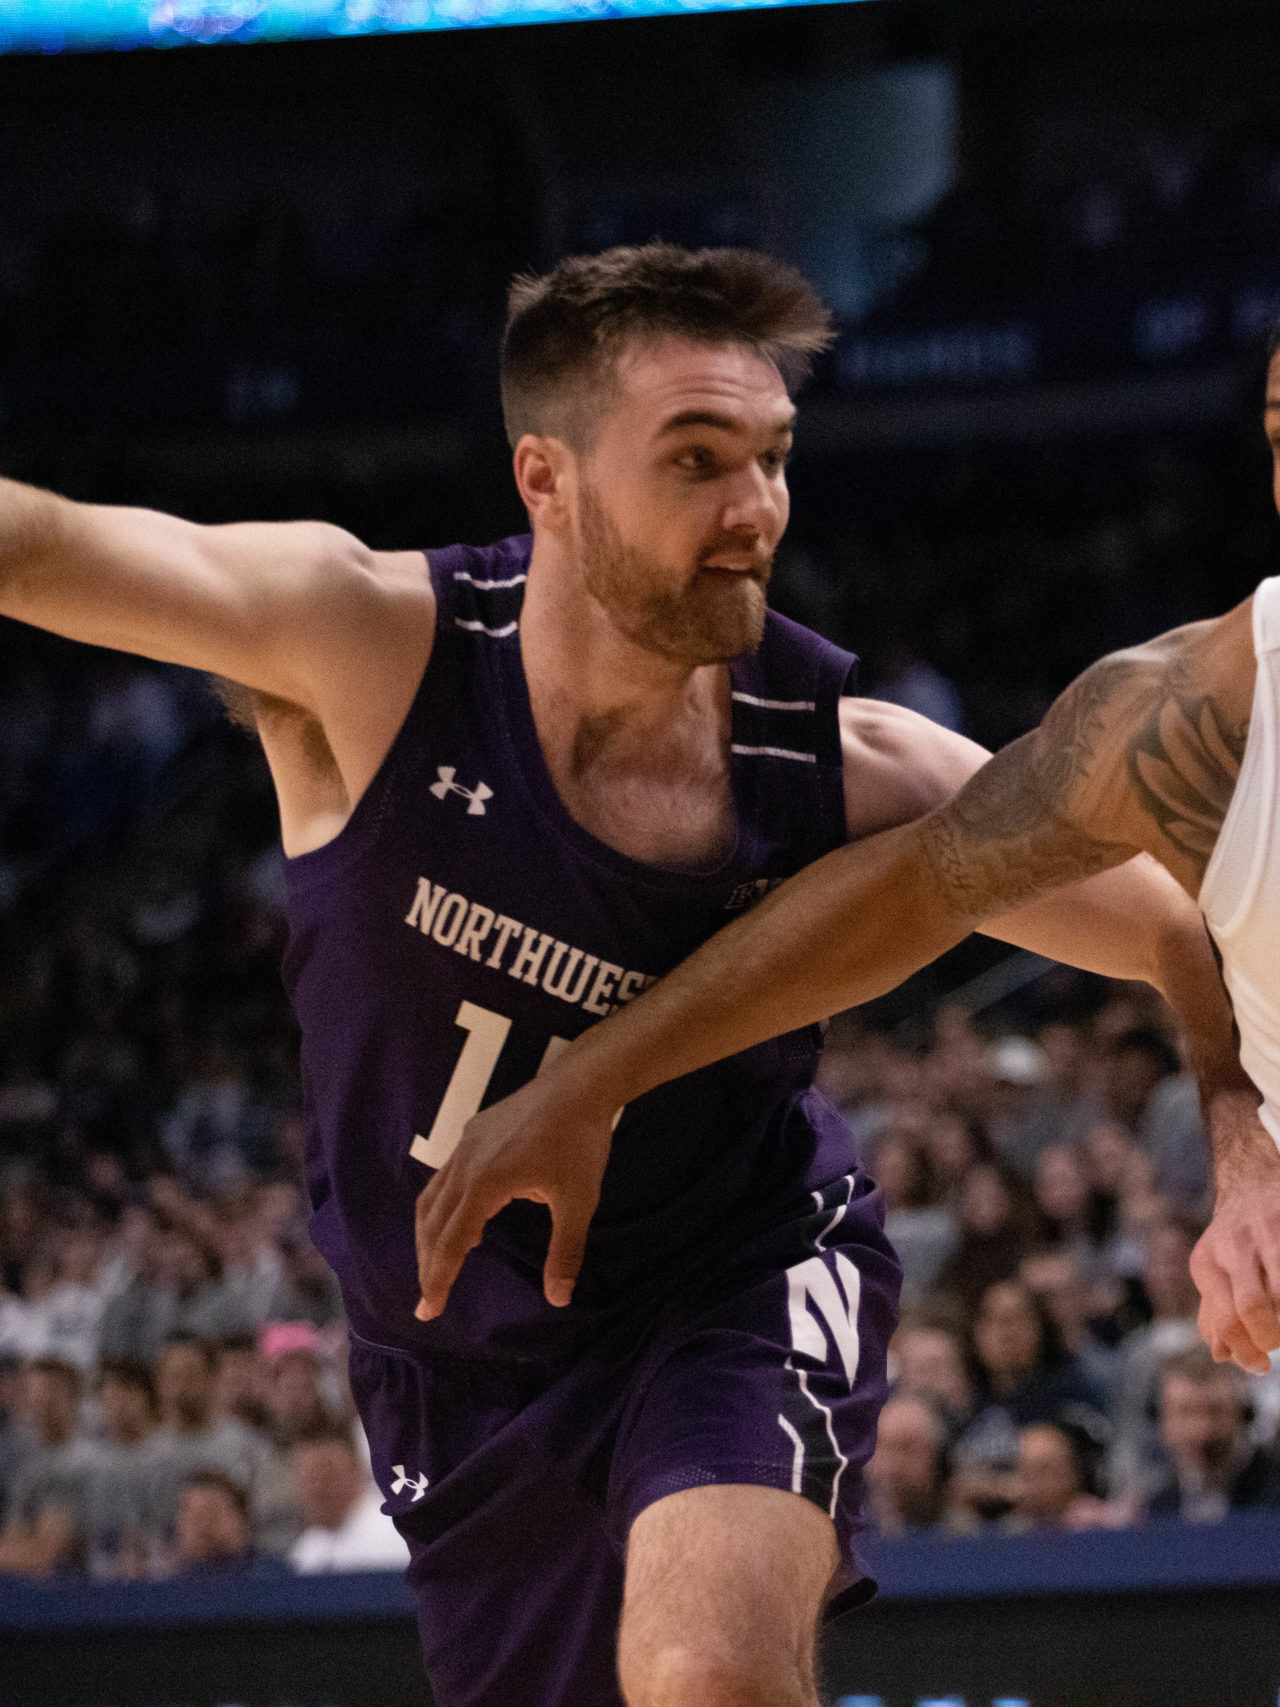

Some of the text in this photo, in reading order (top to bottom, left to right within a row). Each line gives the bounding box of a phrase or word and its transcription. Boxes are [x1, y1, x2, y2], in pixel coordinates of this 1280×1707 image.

[404, 876, 660, 1017] NORTHWES
[409, 1000, 623, 1170] 1
[785, 1250, 861, 1391] N
